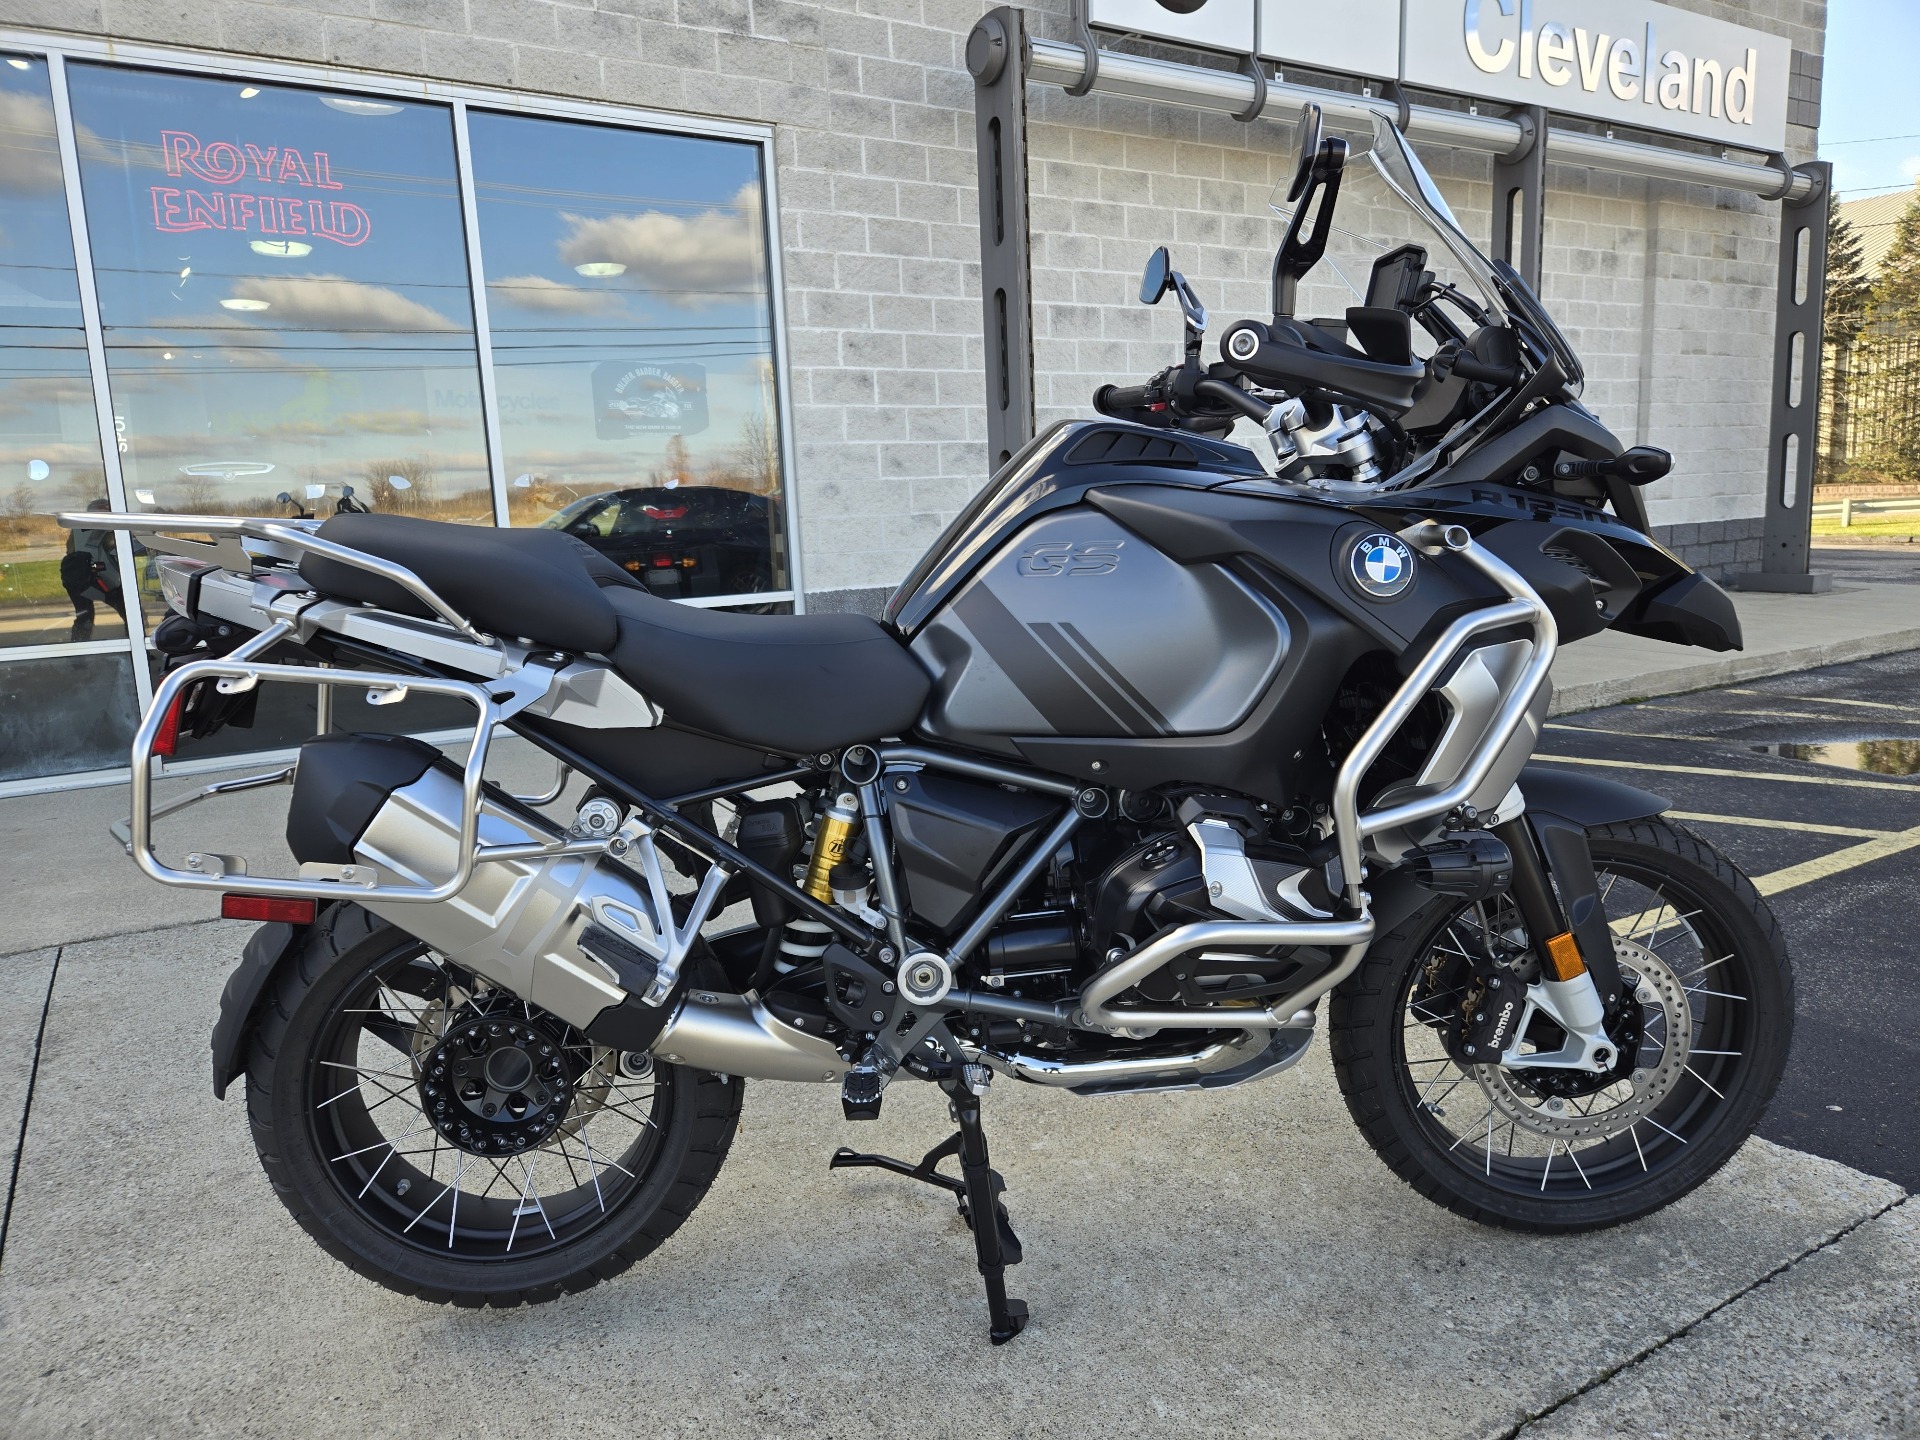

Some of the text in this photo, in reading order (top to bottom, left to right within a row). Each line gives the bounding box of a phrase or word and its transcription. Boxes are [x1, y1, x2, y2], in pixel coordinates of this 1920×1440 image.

[1464, 0, 1756, 125] Cleveland
[160, 129, 343, 190] ROYAL
[150, 186, 371, 247] ENFIELD
[434, 389, 561, 413] Motcycles
[1017, 540, 1125, 577] GS
[1360, 537, 1408, 559] BMW
[1487, 1001, 1514, 1049] brembo
